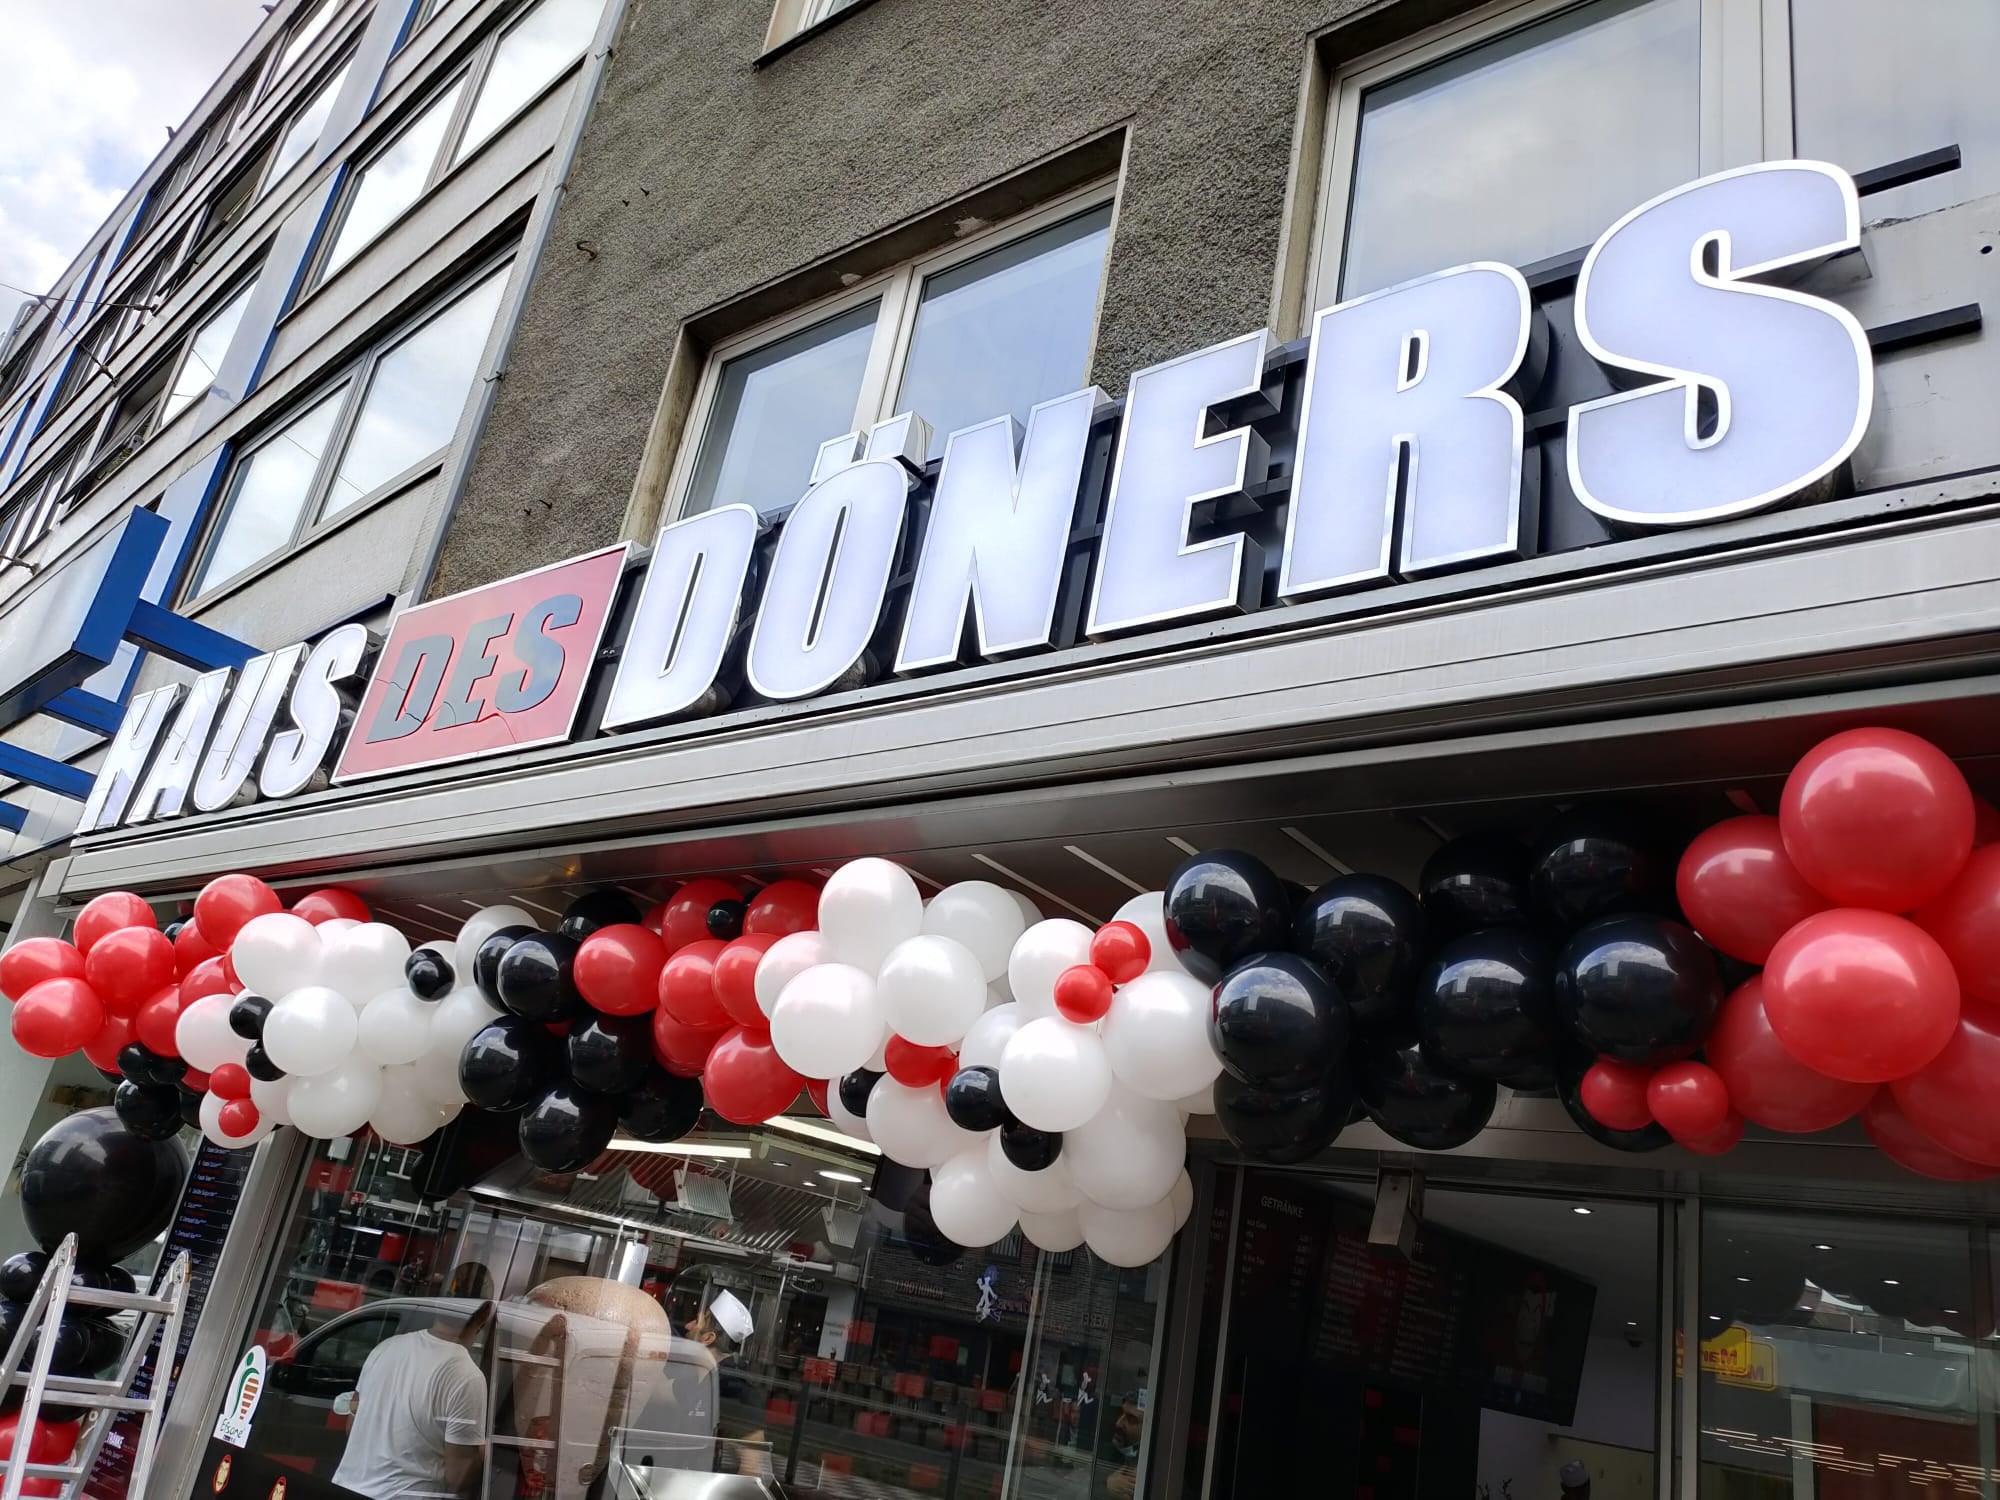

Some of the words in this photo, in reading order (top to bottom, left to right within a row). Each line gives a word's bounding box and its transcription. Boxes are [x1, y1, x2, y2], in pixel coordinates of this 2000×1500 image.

[75, 622, 368, 834] HAUS
[365, 594, 583, 744] DES
[600, 158, 1874, 732] DÖNERS
[1261, 1195, 1305, 1218] GETRÄNKE
